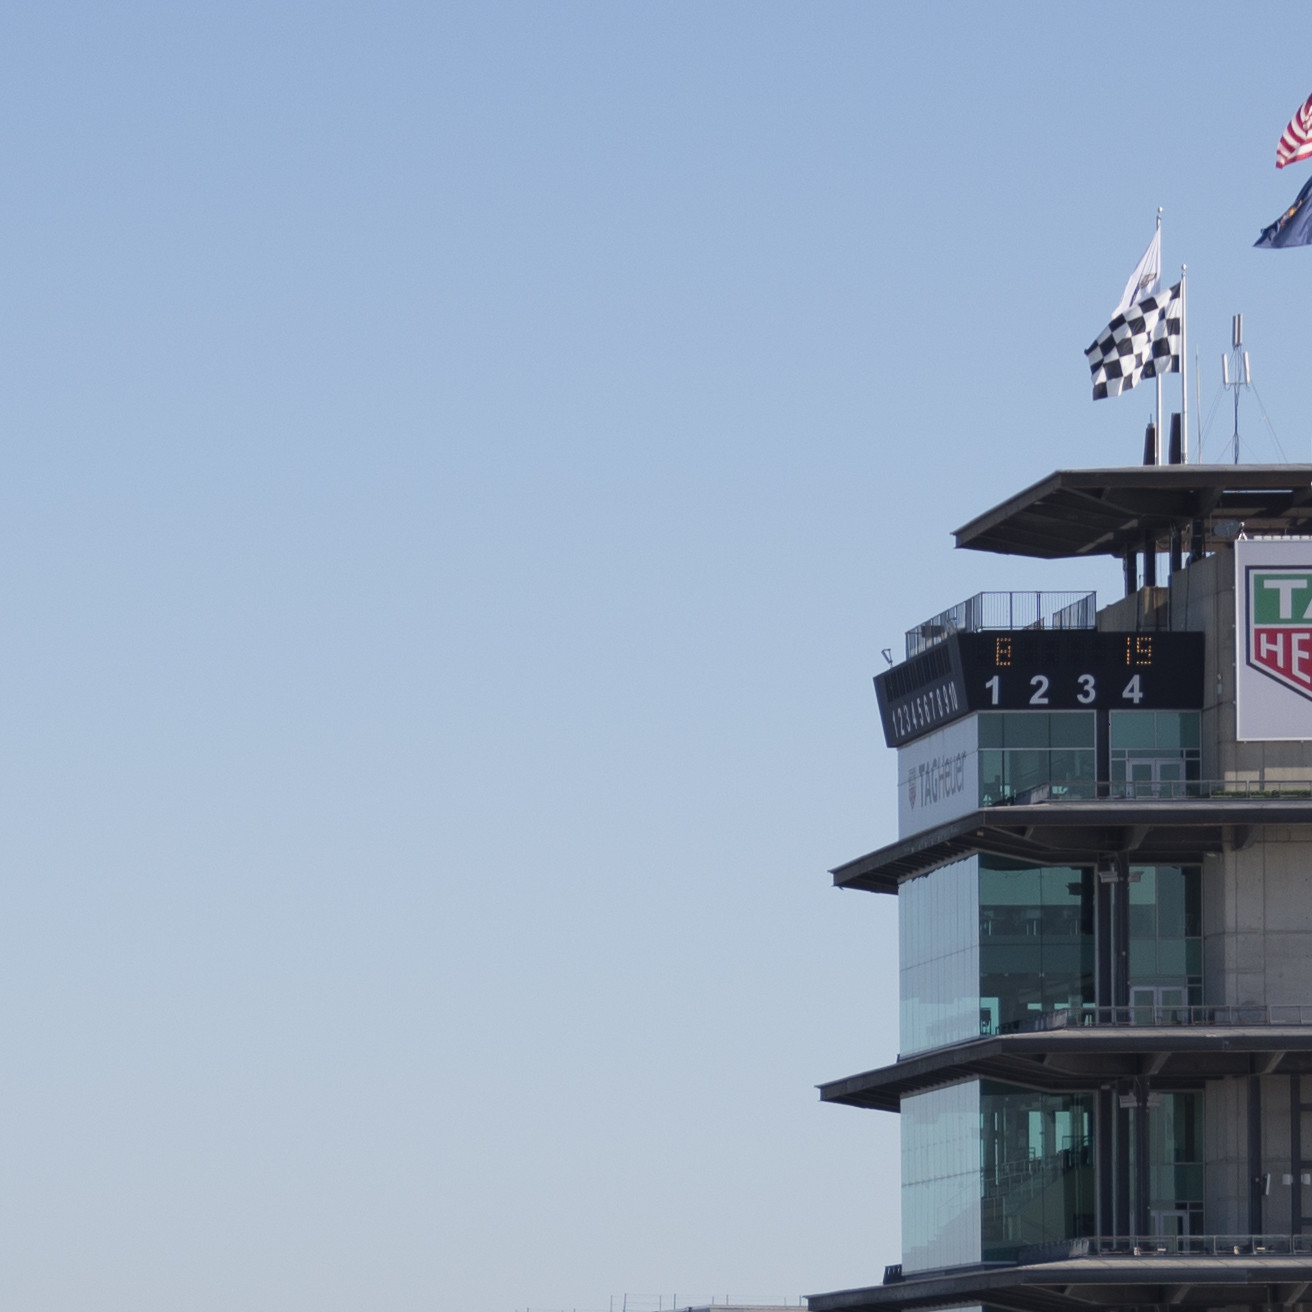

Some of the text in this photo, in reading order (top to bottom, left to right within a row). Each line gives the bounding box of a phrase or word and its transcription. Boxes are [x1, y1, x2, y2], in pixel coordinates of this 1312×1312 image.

[1127, 636, 1152, 666] 15
[985, 675, 1000, 705] 1
[1029, 675, 1049, 705] 2
[1077, 674, 1096, 704] 3
[1122, 674, 1144, 704] 4
